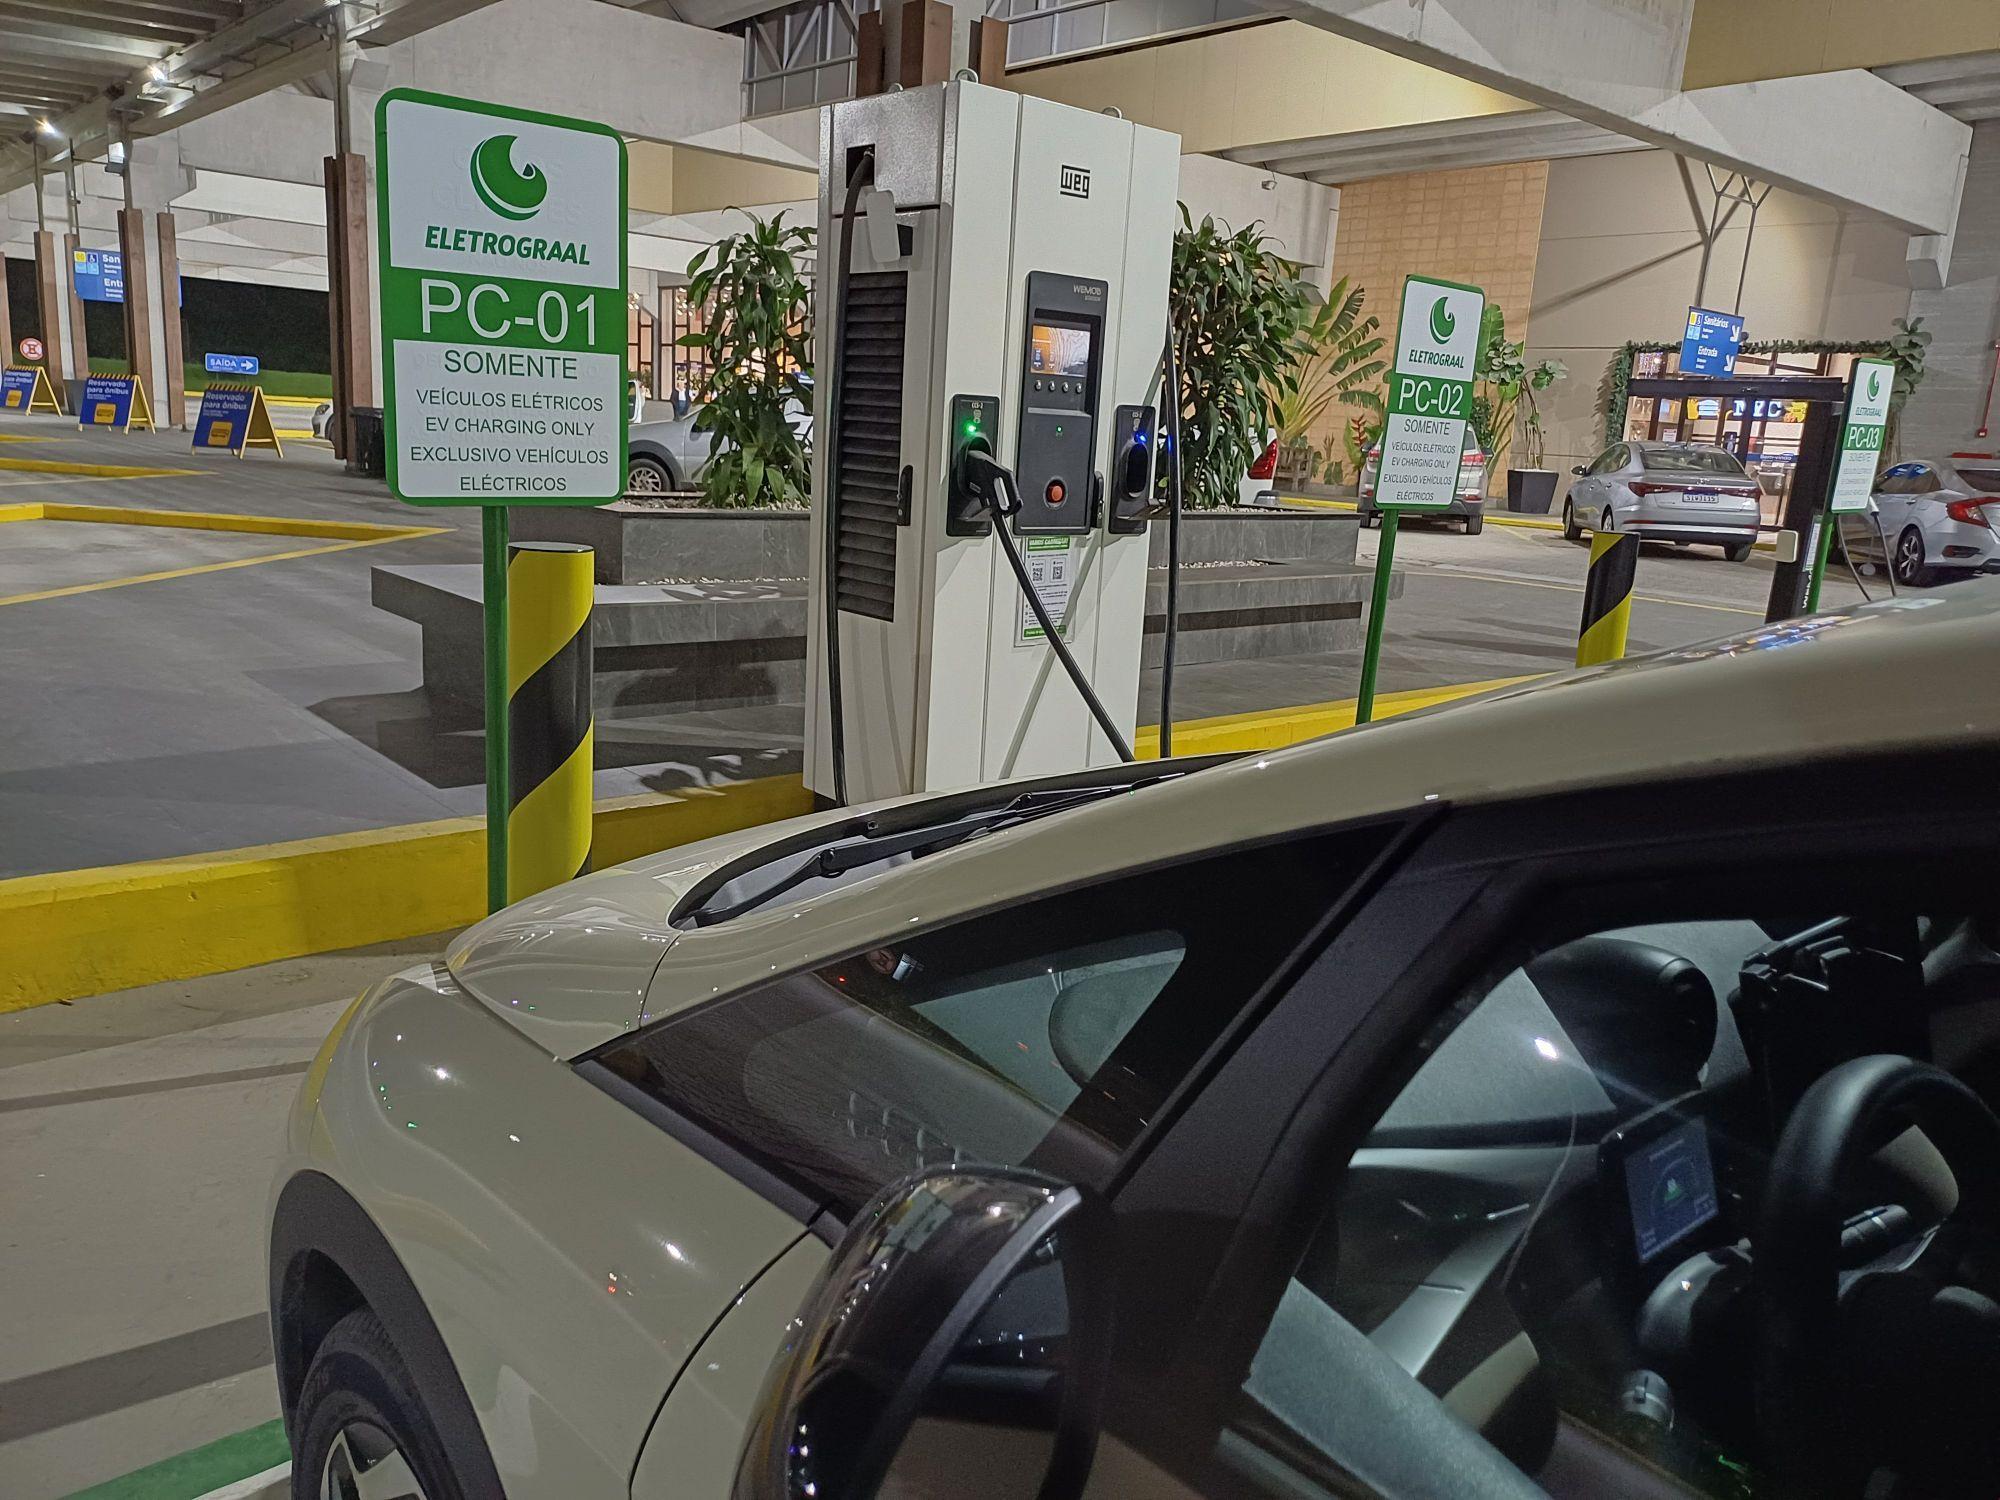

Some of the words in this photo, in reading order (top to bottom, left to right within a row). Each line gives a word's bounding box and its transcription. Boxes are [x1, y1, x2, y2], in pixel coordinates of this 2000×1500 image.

[425, 226, 590, 265] ELETROGRAAL
[421, 278, 595, 346] PC-01
[1408, 349, 1465, 369] ELETROGRAAL
[1697, 345, 1718, 357] Entrada
[210, 358, 237, 367] SAÍDA
[444, 350, 578, 380] SOMENTE
[86, 387, 103, 395] para
[87, 379, 126, 388] Reservado
[205, 391, 245, 401] Reservado
[416, 387, 506, 407] VEÍCULOS
[512, 392, 603, 412] ELÉTRICOS
[1398, 378, 1464, 416] PC-02
[203, 401, 221, 409] para
[426, 416, 449, 432] EV
[455, 417, 546, 434] CHARGING
[552, 421, 595, 436] ONLY
[1404, 418, 1451, 435] SOMENTE
[1847, 426, 1880, 448] PC-03
[411, 446, 511, 463] EXCLUSIVO
[516, 446, 609, 464] VEHÍCULOS
[1391, 441, 1423, 453] VEÍCULOS
[1391, 457, 1400, 466] EV
[1401, 457, 1433, 468] CHARGING
[1434, 459, 1451, 469] ONLY
[460, 474, 567, 491] ELÉCTRICOS
[1384, 473, 1418, 484] EXCLUSIVO
[1419, 474, 1452, 485] VEHÍCULOS
[1396, 490, 1434, 501] ELÉCTRICOS
